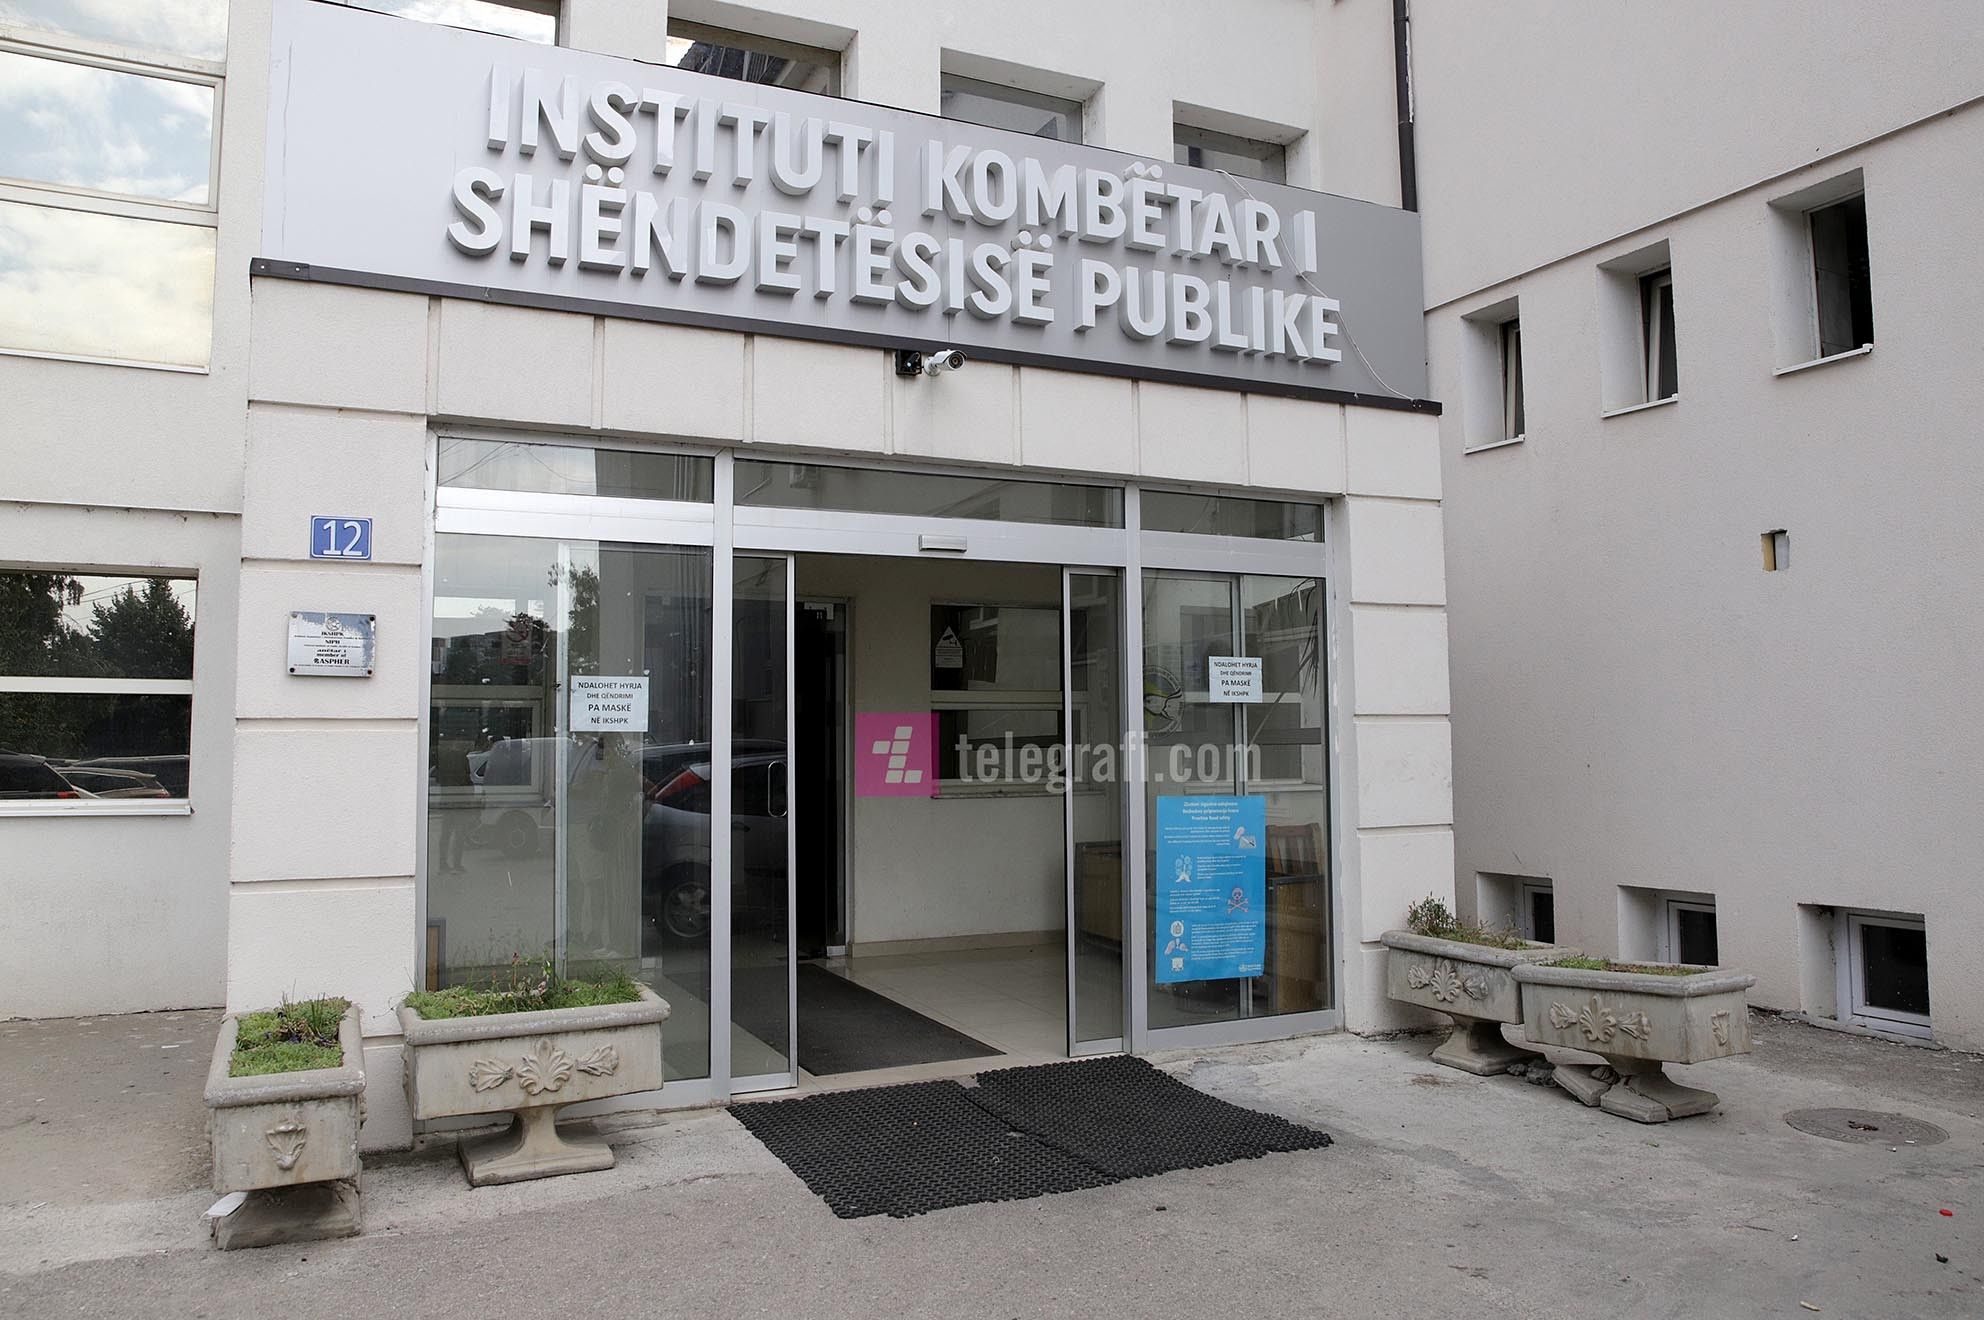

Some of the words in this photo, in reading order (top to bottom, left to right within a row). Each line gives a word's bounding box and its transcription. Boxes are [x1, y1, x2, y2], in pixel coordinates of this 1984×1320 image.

[487, 64, 894, 208] INSTITUTI
[922, 140, 1281, 271] KOMBËTAR
[1294, 210, 1316, 277] I
[447, 164, 1054, 327] SHËNDETËSISË
[1073, 258, 1342, 367] PUBLIKE
[323, 519, 363, 556] 12
[602, 703, 632, 712] MASKË
